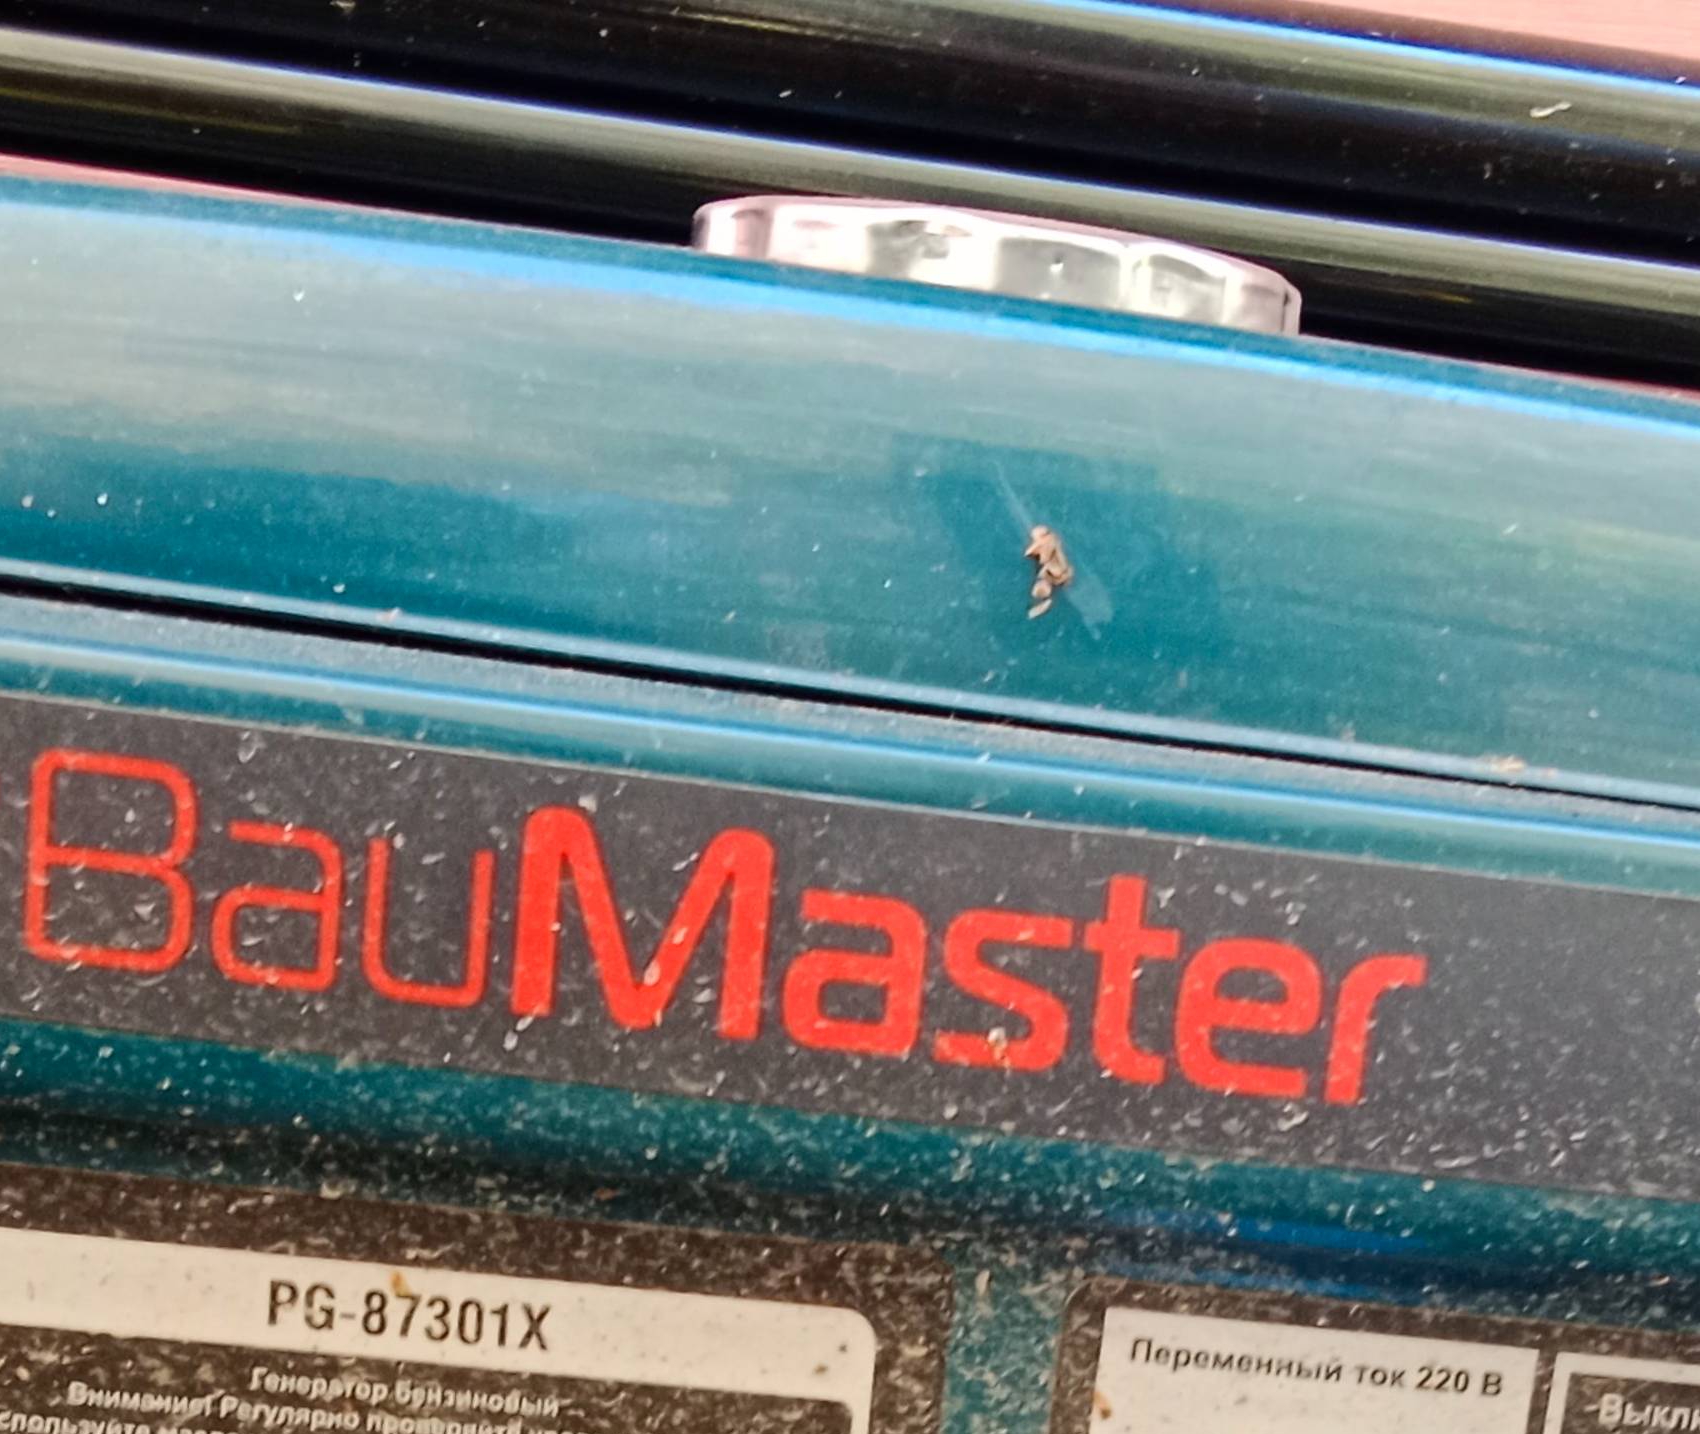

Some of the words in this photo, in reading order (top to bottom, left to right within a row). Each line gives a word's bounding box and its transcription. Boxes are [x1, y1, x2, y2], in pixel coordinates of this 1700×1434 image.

[22, 747, 1428, 1106] BauMaster
[267, 1279, 551, 1351] PG-87301X
[1129, 1337, 1343, 1384] Переменный
[1357, 1365, 1406, 1388] ток
[1416, 1365, 1470, 1394] 220
